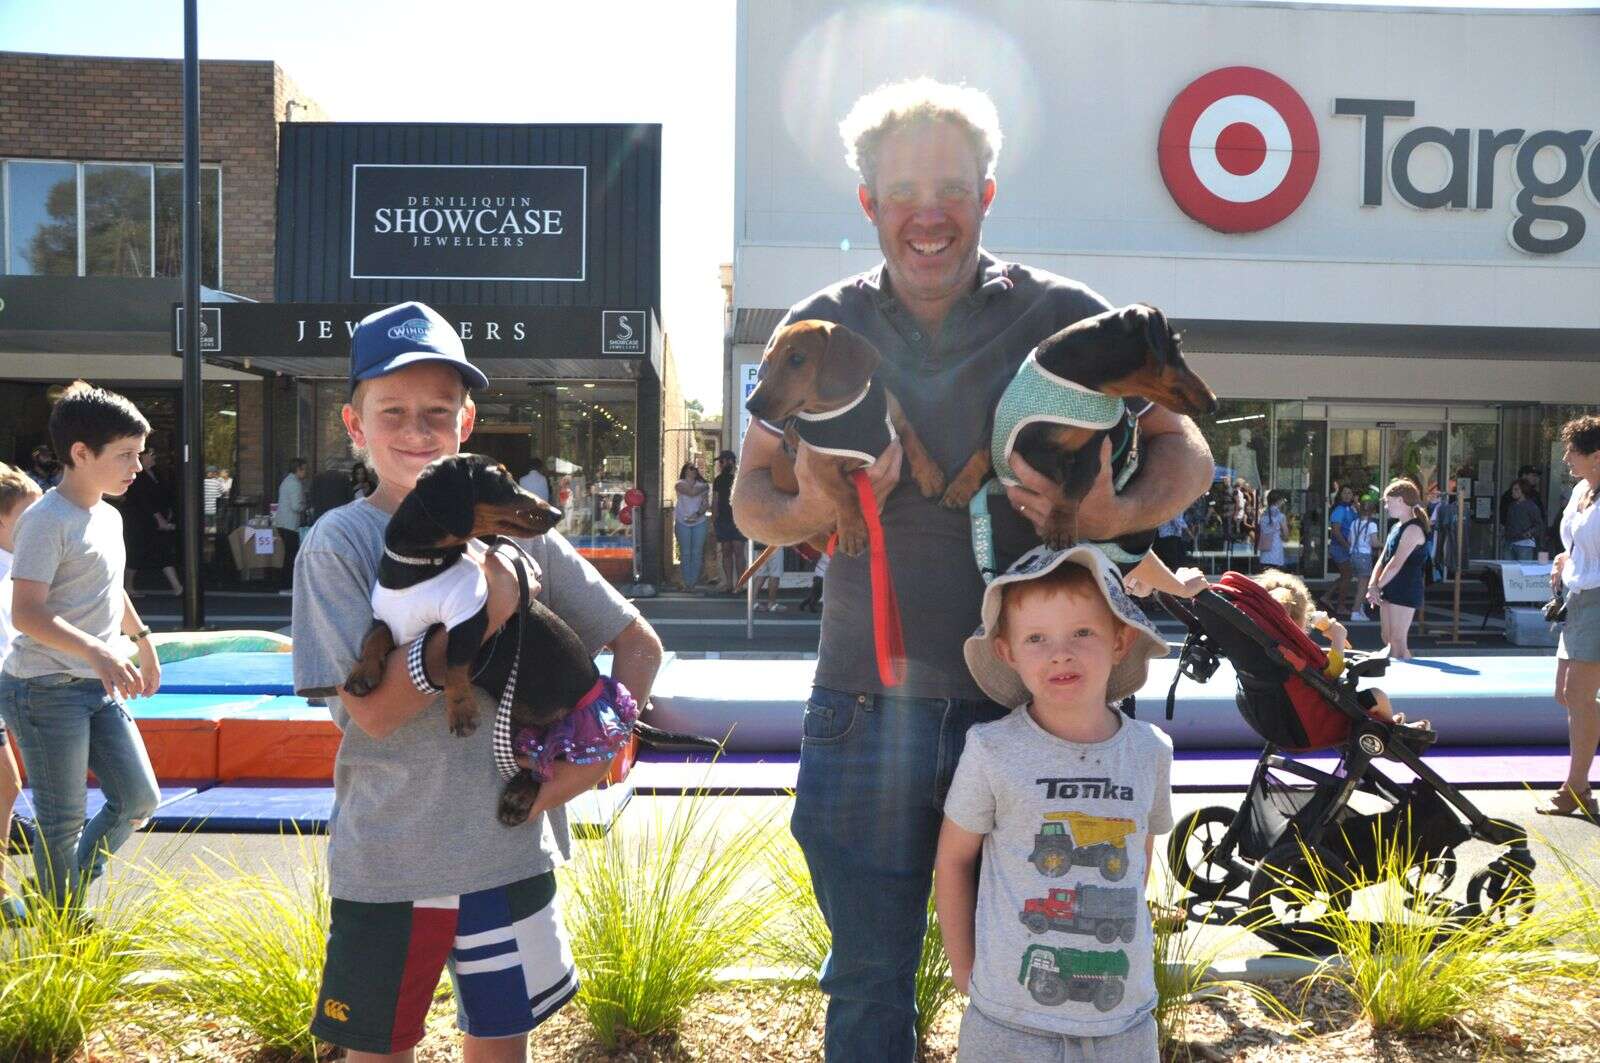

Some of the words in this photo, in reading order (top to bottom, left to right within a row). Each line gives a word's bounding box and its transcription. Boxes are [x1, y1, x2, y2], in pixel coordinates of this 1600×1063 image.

[1332, 97, 1600, 254] Targ
[407, 196, 532, 208] DENILIQUIN
[374, 208, 564, 235] SHOWCASE
[412, 236, 525, 248] JEWELLERS
[297, 320, 526, 342] JEERS
[1036, 778, 1134, 801] Tonka
